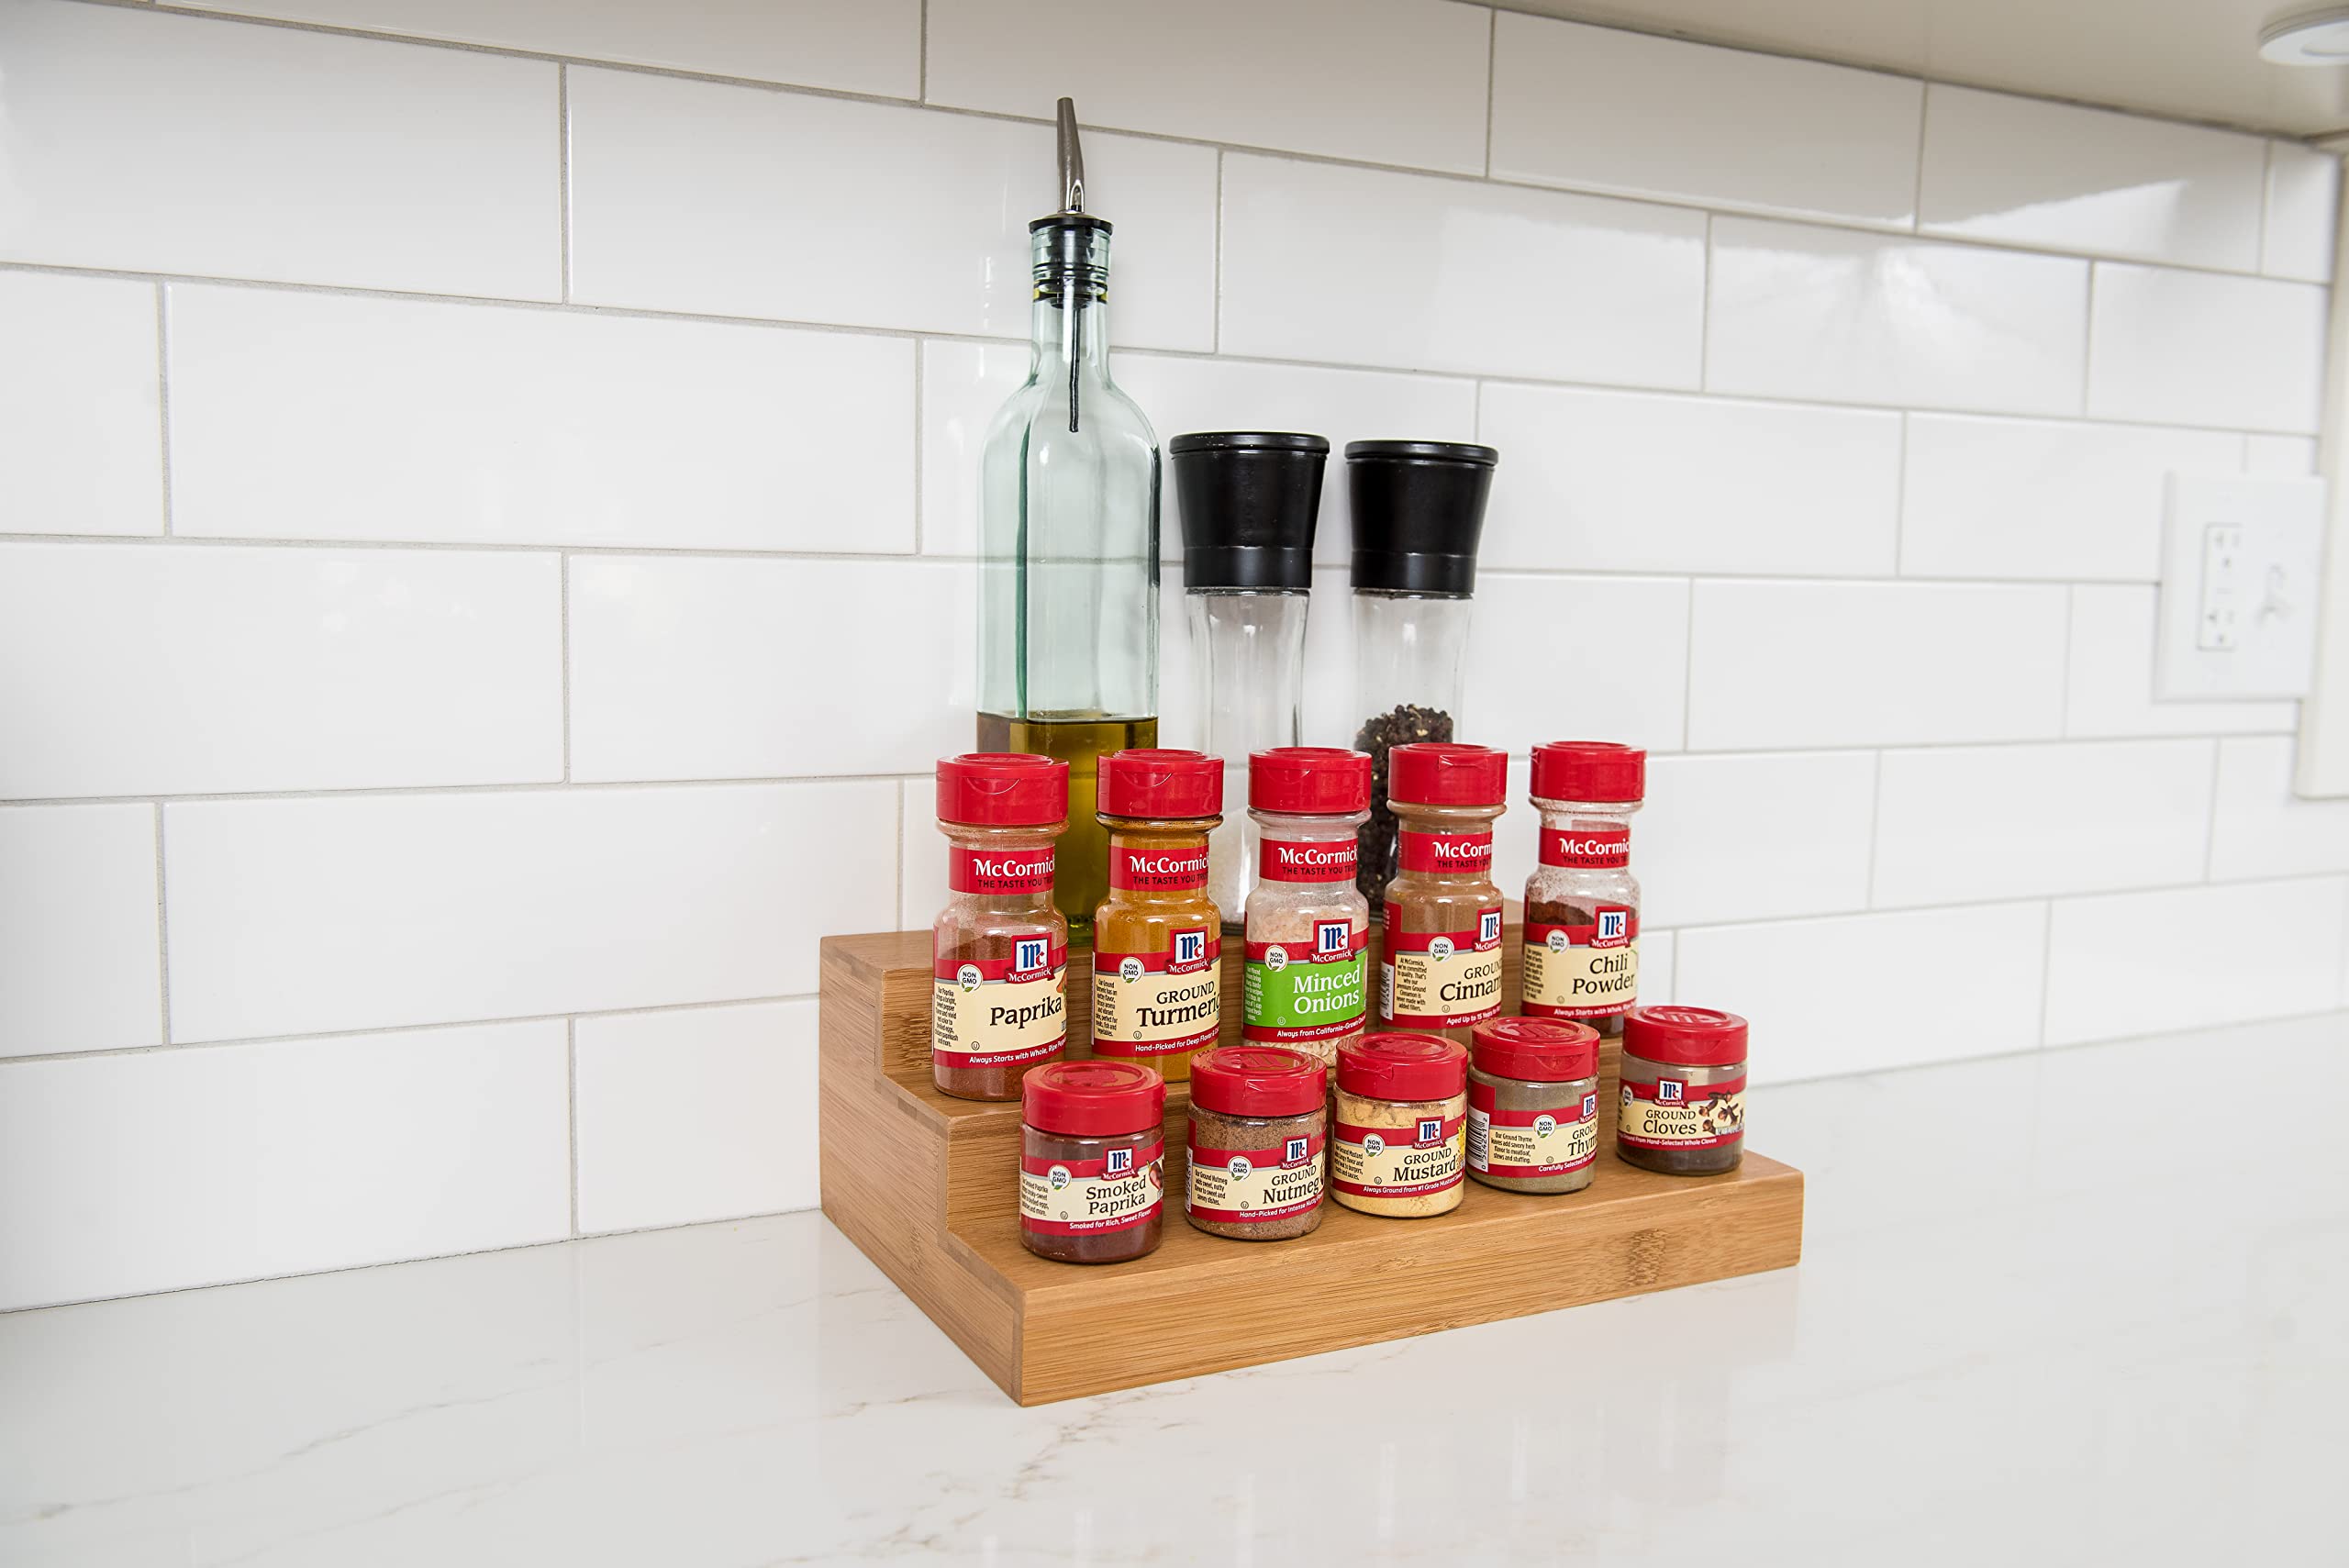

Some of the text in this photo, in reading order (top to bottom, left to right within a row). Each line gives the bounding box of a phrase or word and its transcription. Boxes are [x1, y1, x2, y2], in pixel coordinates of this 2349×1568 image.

[1432, 840, 1493, 857] McCorm
[997, 880, 1024, 888] TASTE
[1028, 878, 1041, 886] YOU
[1133, 876, 1149, 884] THE
[1312, 950, 1353, 962] McCormick
[1169, 959, 1208, 973] McCormick
[1589, 953, 1628, 974] Chili
[962, 971, 976, 979] NON
[1008, 968, 1052, 982] McCormick
[1293, 964, 1360, 994] Minced
[1572, 973, 1634, 995] Powder
[1156, 981, 1214, 1005] GROUND
[1294, 990, 1359, 1014] Onions
[990, 996, 1062, 1029] Paprika
[1554, 1008, 1575, 1017] Always
[1316, 1020, 1359, 1034] California-Grown
[1446, 1017, 1462, 1025] Aged
[1135, 1042, 1175, 1051] Hand-Picked
[969, 1056, 992, 1064] Always
[1030, 1048, 1048, 1057] Whole,
[1646, 1110, 1696, 1119] GROUND
[1643, 1120, 1697, 1134] Cloves
[1404, 1148, 1452, 1165] GROUND
[1393, 1155, 1456, 1182] Mustard
[1539, 1158, 1582, 1172] Carefully Selected
[1272, 1165, 1316, 1185] GROUND
[1085, 1174, 1146, 1200] Smoked
[1263, 1177, 1319, 1204] Nutmeg
[1088, 1193, 1145, 1216] Paprika
[1287, 1203, 1306, 1213] Intense
[1106, 1219, 1120, 1228] Rich,
[1121, 1215, 1137, 1224] Sweet
